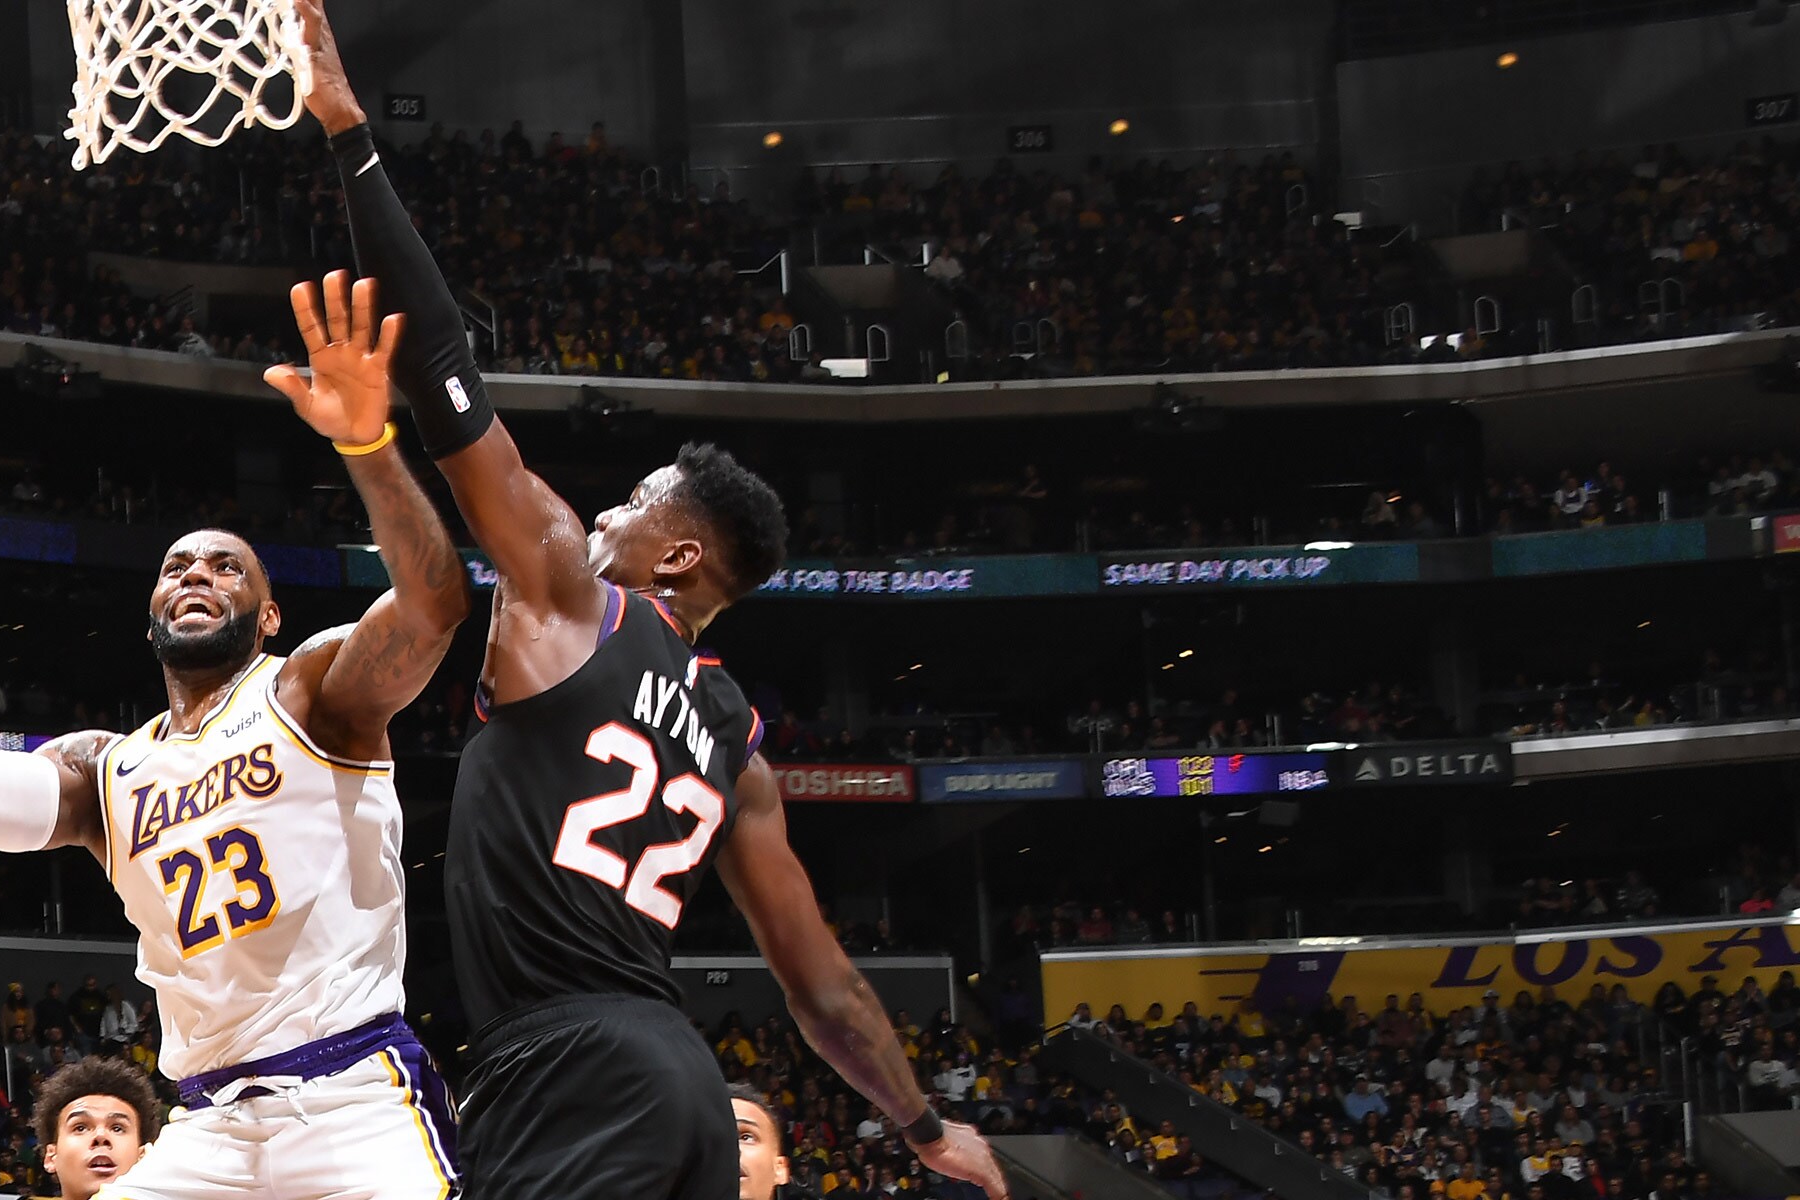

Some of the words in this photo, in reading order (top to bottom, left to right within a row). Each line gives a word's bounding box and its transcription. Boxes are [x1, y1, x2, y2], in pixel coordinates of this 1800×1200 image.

[391, 98, 419, 116] 305
[1754, 99, 1792, 120] 307
[1015, 130, 1046, 148] 306
[791, 569, 841, 593] FOR
[842, 568, 890, 593] THE
[890, 568, 975, 593] BADGE
[1102, 562, 1177, 587] SAME
[1175, 559, 1231, 585] DAY
[1227, 557, 1292, 583] PICK
[1290, 555, 1332, 580] UP
[221, 710, 262, 739] wish
[633, 670, 715, 776] AYTON
[1390, 754, 1499, 777] DELTA
[772, 768, 910, 797] TOSHIBA
[945, 773, 1003, 793] BUD
[1004, 771, 1060, 790] LIGHT
[127, 742, 285, 863] LAKERS
[551, 719, 726, 931] 22
[154, 824, 282, 962] 23
[1430, 936, 1665, 989] LOS
